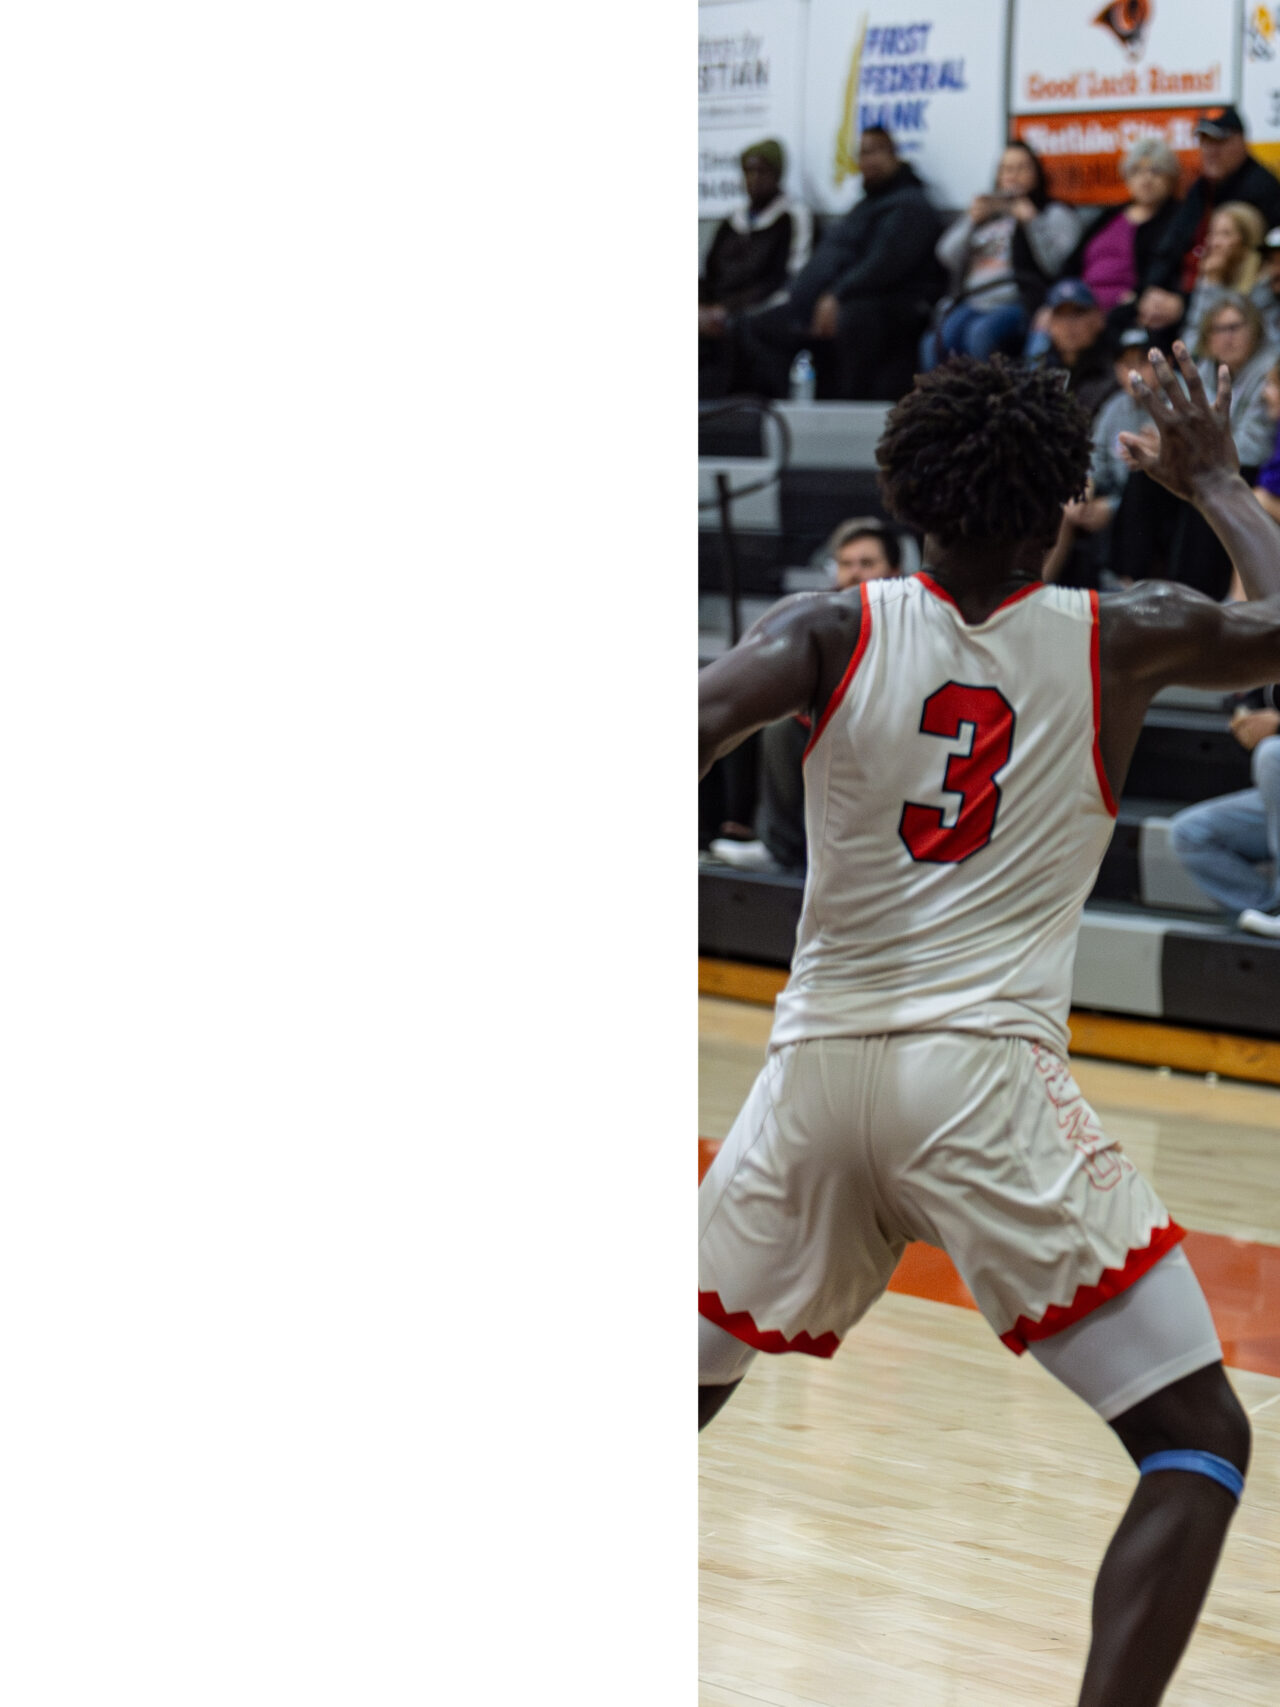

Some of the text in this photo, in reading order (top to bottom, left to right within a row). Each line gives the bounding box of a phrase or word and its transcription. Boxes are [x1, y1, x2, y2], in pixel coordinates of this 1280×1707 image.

[865, 22, 932, 54] FIRST
[862, 58, 968, 94] FEDERAL
[1028, 72, 1079, 99] Good
[1087, 69, 1138, 97] Luck
[859, 100, 929, 134] BANK
[898, 679, 1017, 864] 3
